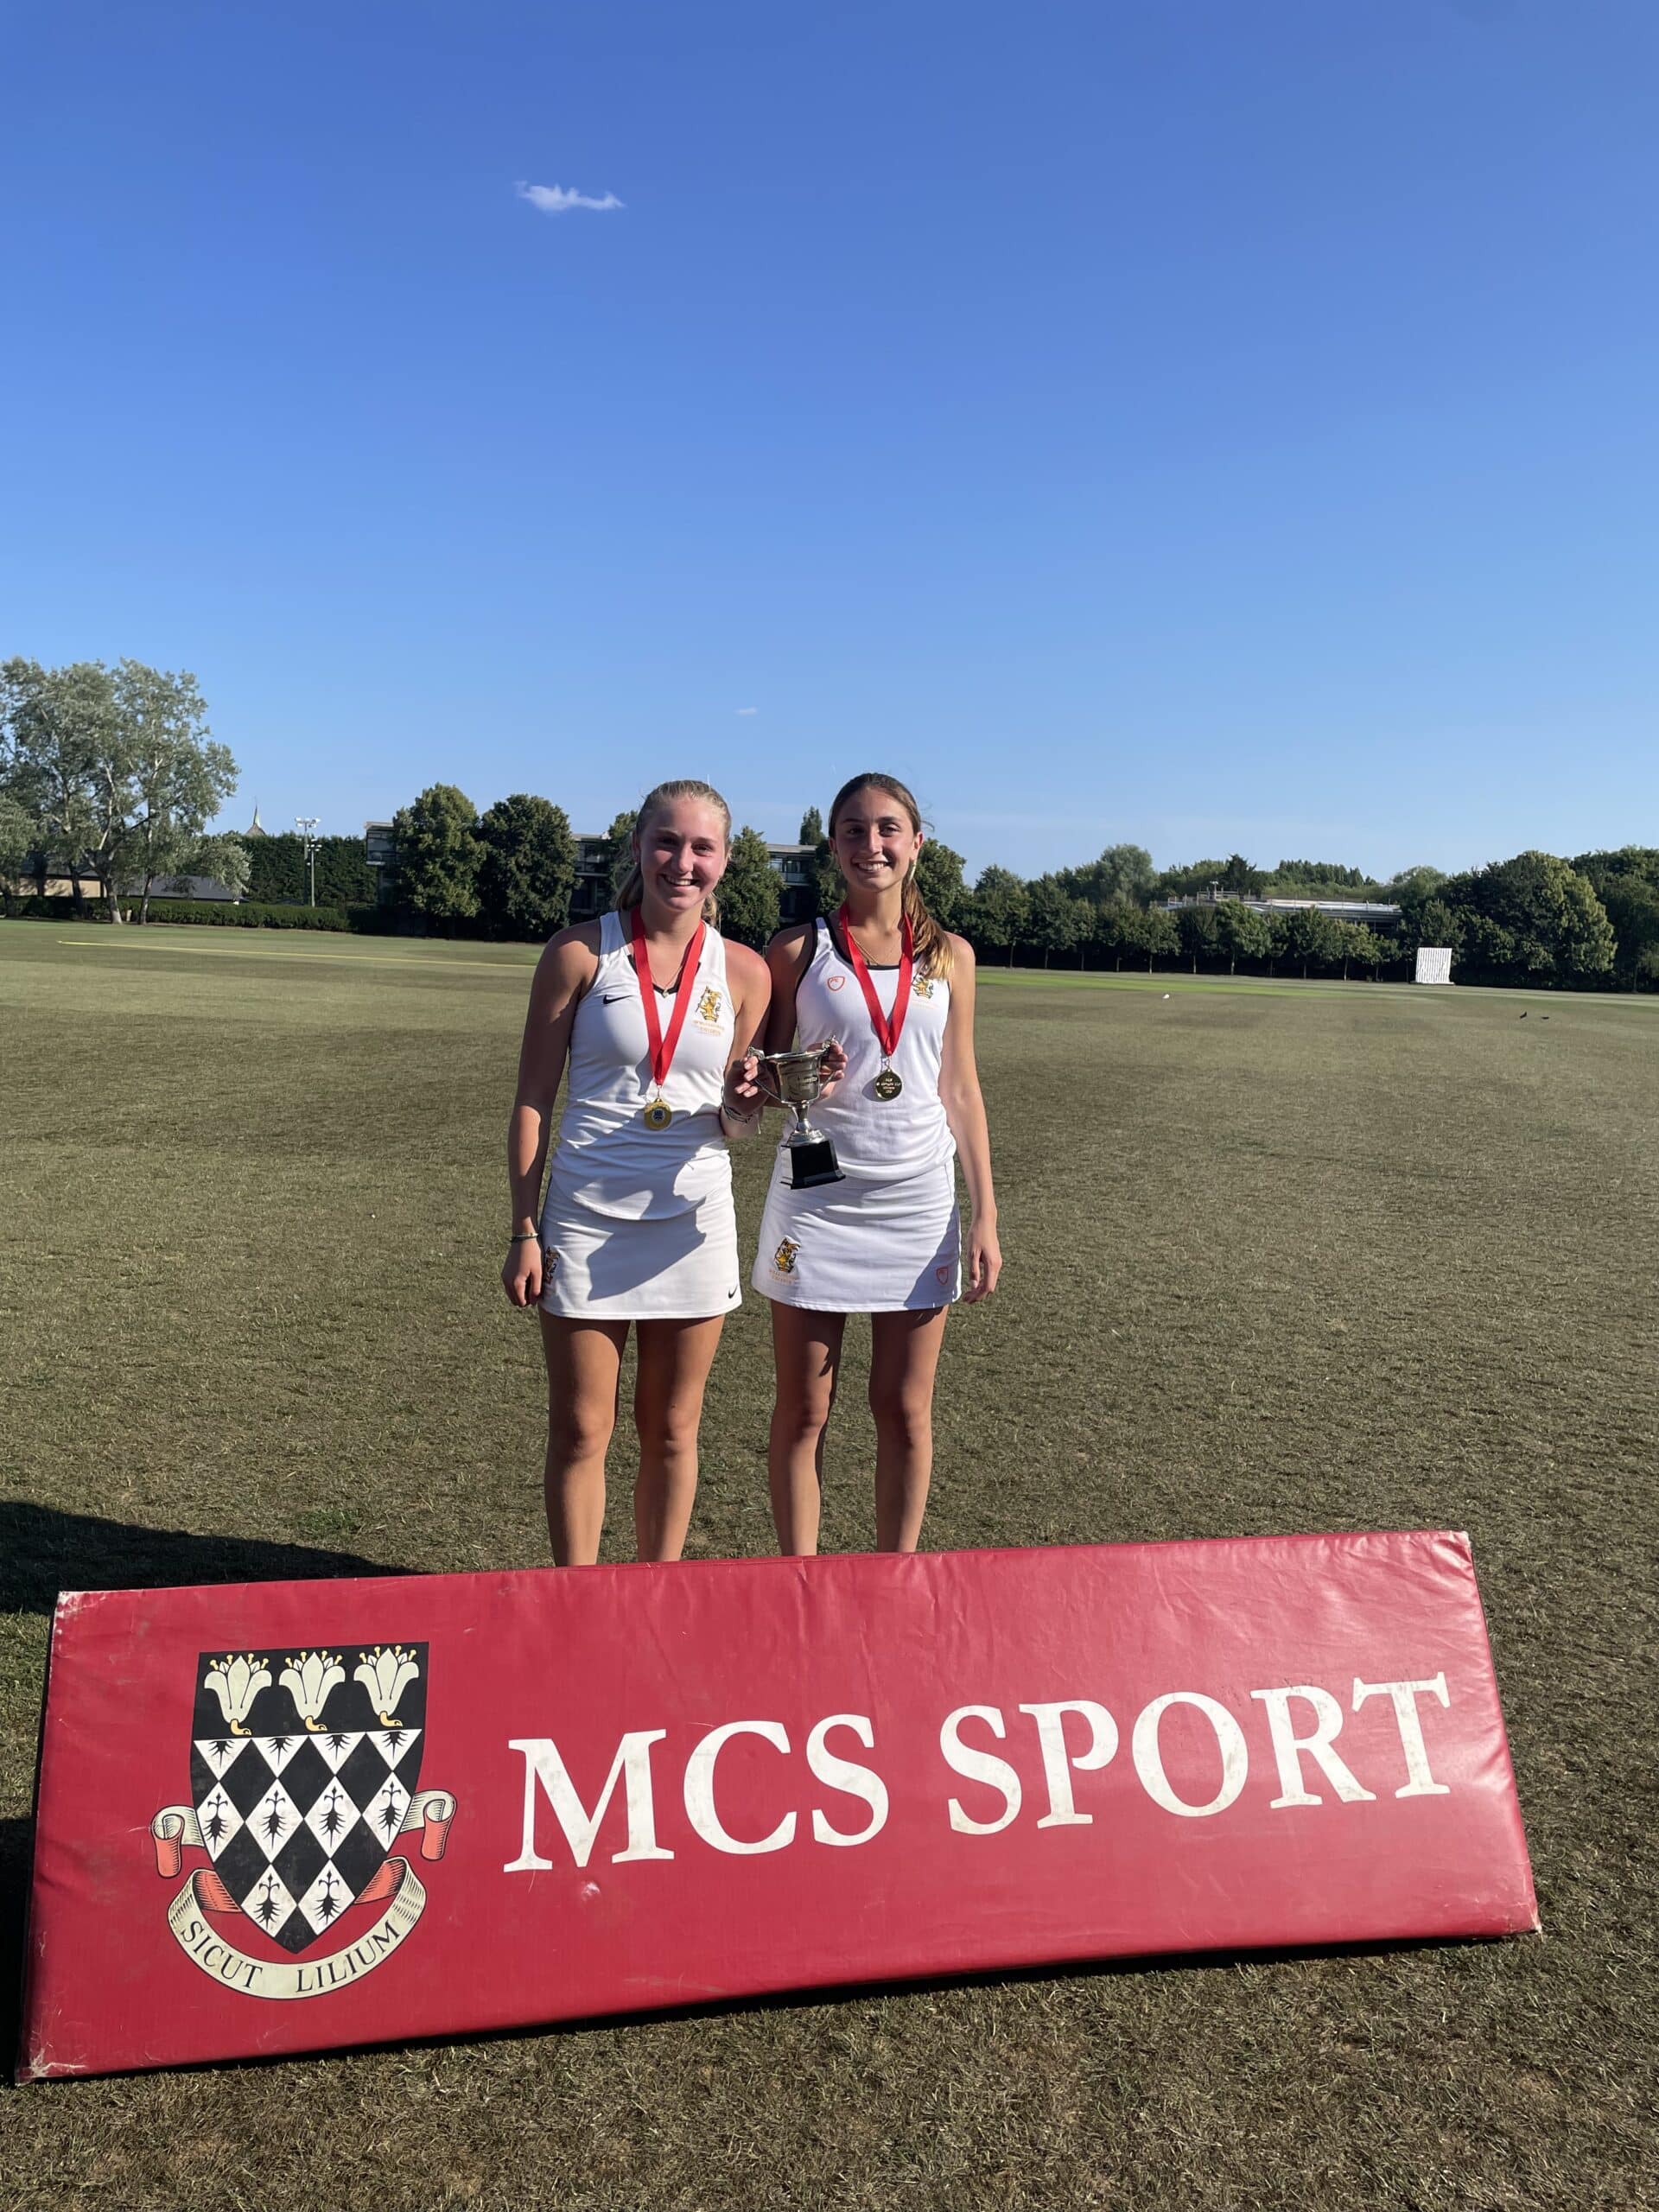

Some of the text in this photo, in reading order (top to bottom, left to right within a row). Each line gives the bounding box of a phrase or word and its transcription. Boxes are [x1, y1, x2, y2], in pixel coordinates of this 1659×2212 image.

[504, 1671, 1451, 1872] MCS SPORT
[181, 1919, 401, 1993] SICUT LILIUM
